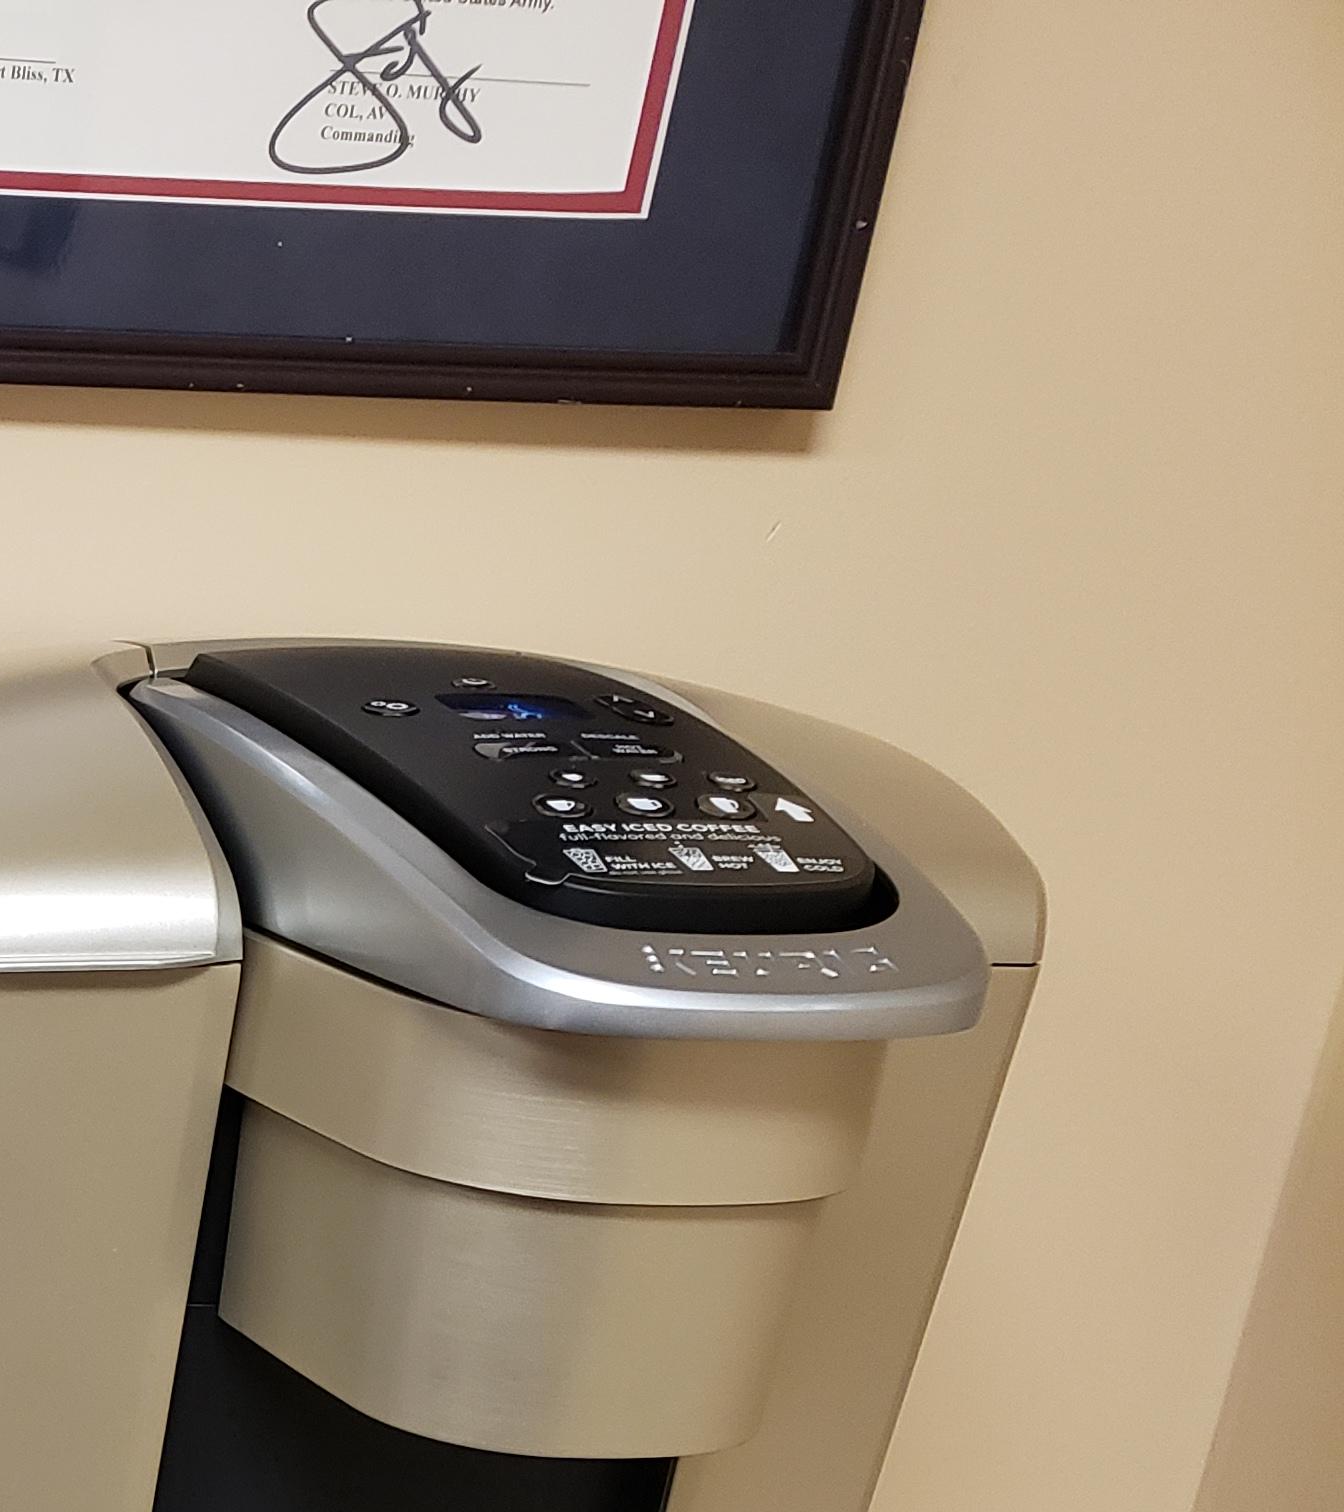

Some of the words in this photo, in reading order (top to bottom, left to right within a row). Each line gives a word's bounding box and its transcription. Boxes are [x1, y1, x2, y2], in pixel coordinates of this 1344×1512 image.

[12, 65, 48, 83] Bliss,
[52, 67, 75, 84] TX
[324, 102, 365, 121] COL,
[562, 824, 616, 833] EASY
[622, 823, 672, 832] ICED
[677, 824, 760, 834] COFFEE
[559, 832, 668, 842] full-flavored
[673, 833, 705, 841] and
[710, 833, 782, 842] delicious
[612, 862, 649, 870] WITH
[651, 862, 678, 870] ICE
